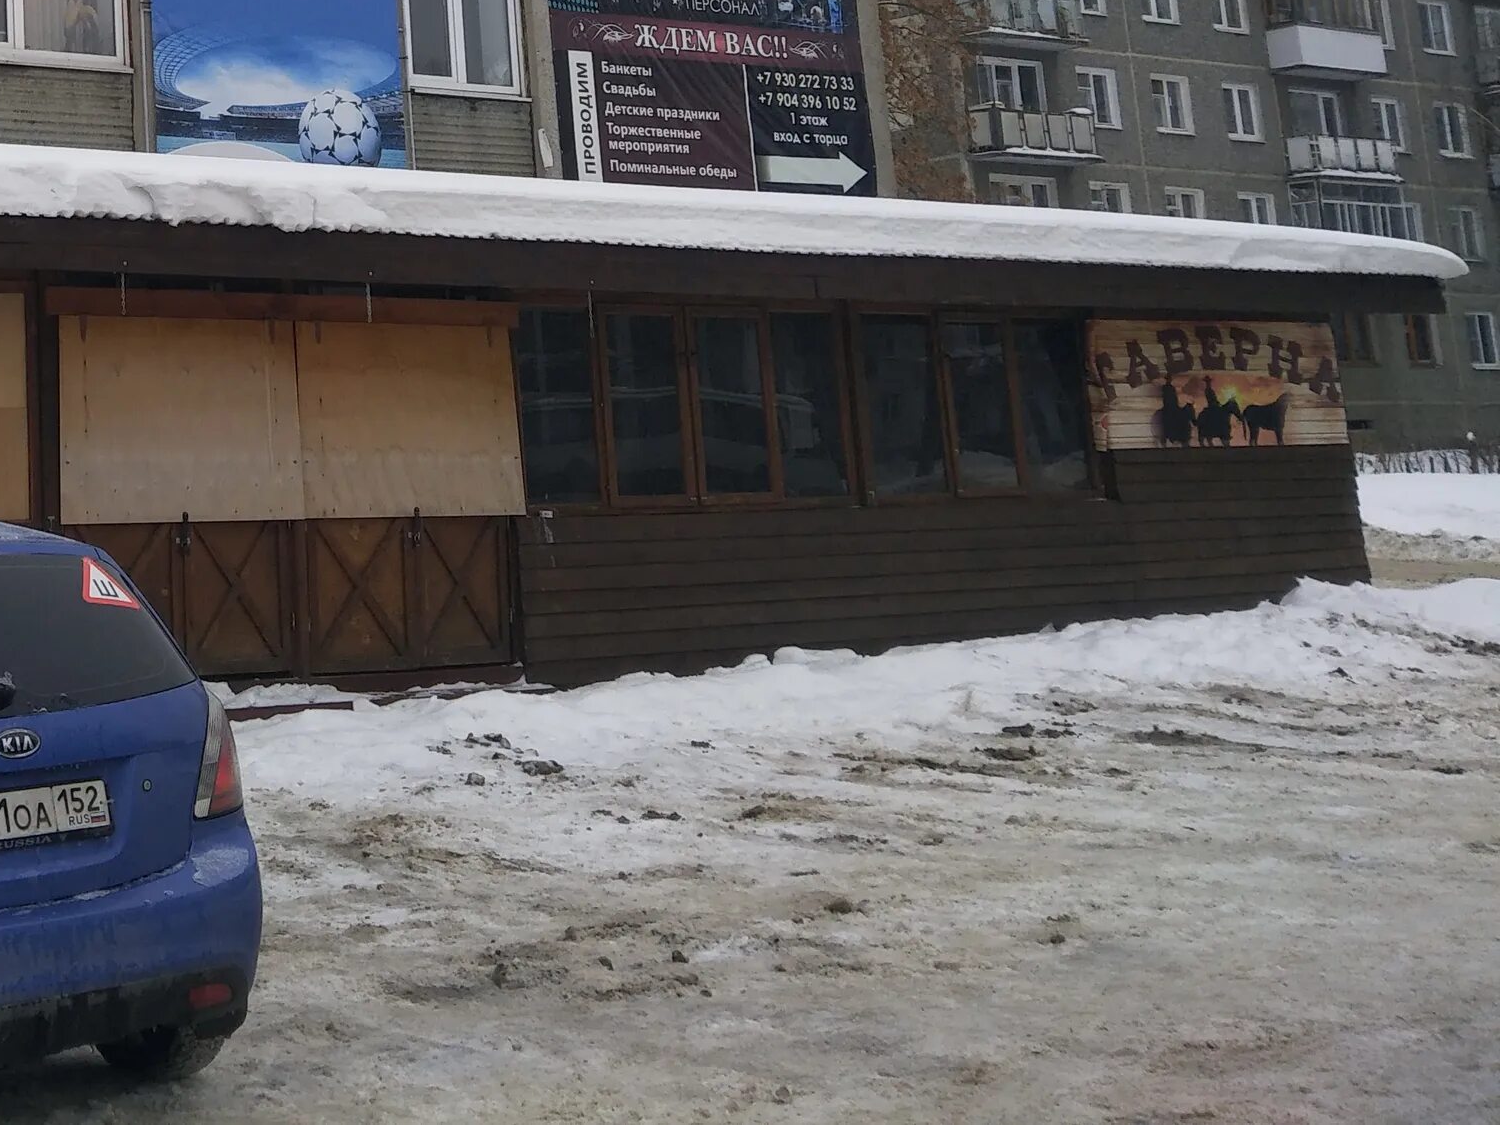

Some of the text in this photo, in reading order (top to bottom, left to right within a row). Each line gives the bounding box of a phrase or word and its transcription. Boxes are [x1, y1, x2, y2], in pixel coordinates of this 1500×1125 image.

[634, 23, 789, 59] ЖДЕМ ВАС!!
[601, 60, 653, 77] Банкеты
[603, 81, 656, 97] Свадьбы
[756, 73, 854, 91] +7 930 272 73 33
[758, 93, 857, 111] +7 904 396 10 52
[576, 62, 597, 175] ПРОВОДИМ
[605, 101, 720, 122] Детские праздники
[791, 112, 829, 127] 1 этаж
[606, 121, 702, 140] Торжественные
[774, 131, 800, 145] вход
[813, 133, 848, 147] торца
[608, 139, 690, 156] мероприятия
[610, 159, 737, 180] Поминальные обеды
[1, 735, 34, 753] KIA
[57, 785, 101, 815] 152
[68, 814, 91, 826] RUS
